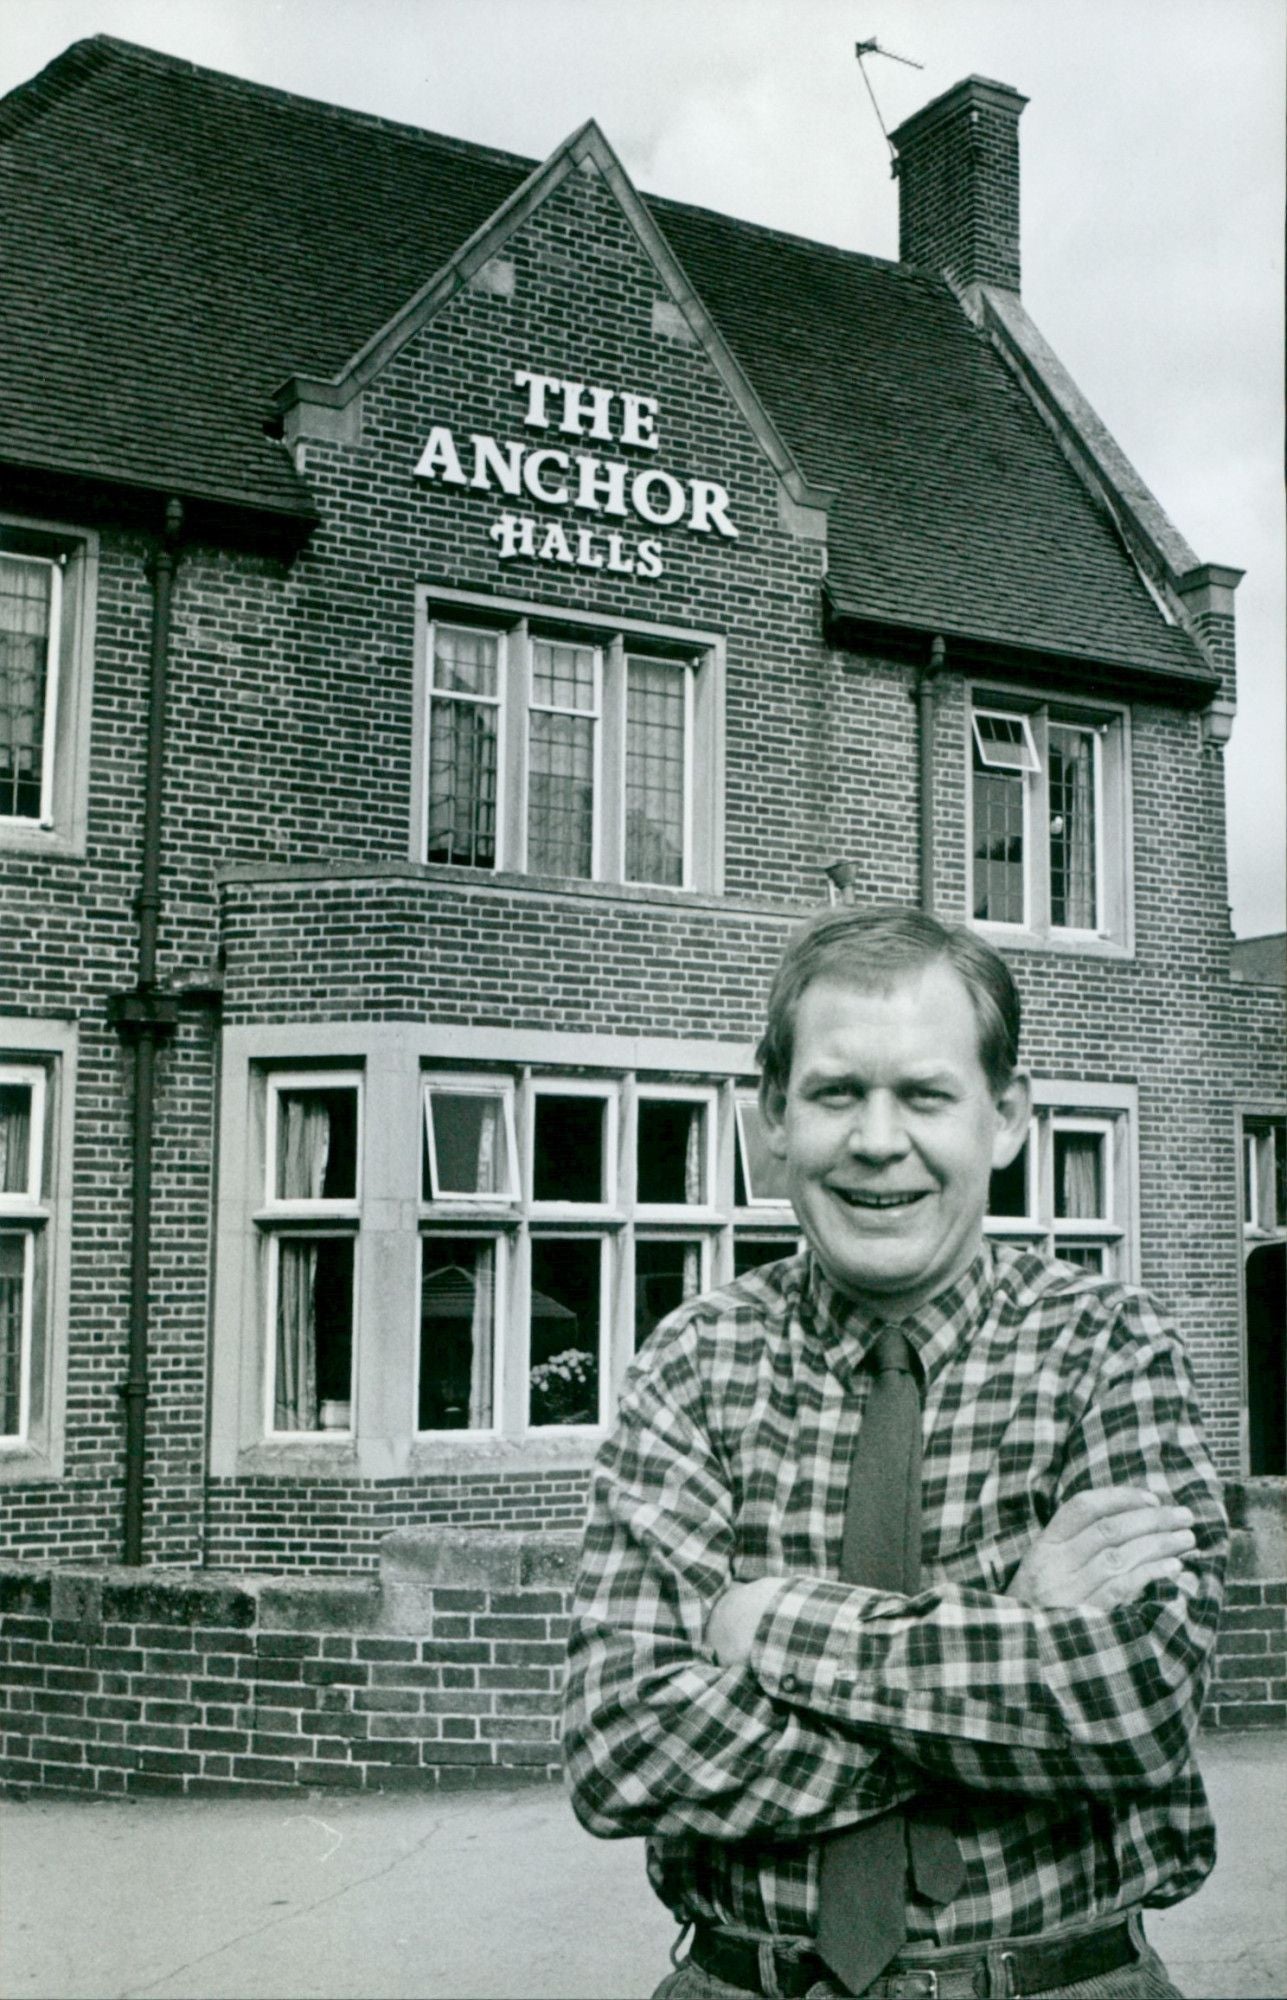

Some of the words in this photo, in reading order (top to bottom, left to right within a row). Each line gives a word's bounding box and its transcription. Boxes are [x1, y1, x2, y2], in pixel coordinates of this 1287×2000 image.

[515, 370, 659, 450] THE
[413, 426, 739, 538] ANCHOR
[490, 514, 663, 578] HALLS
